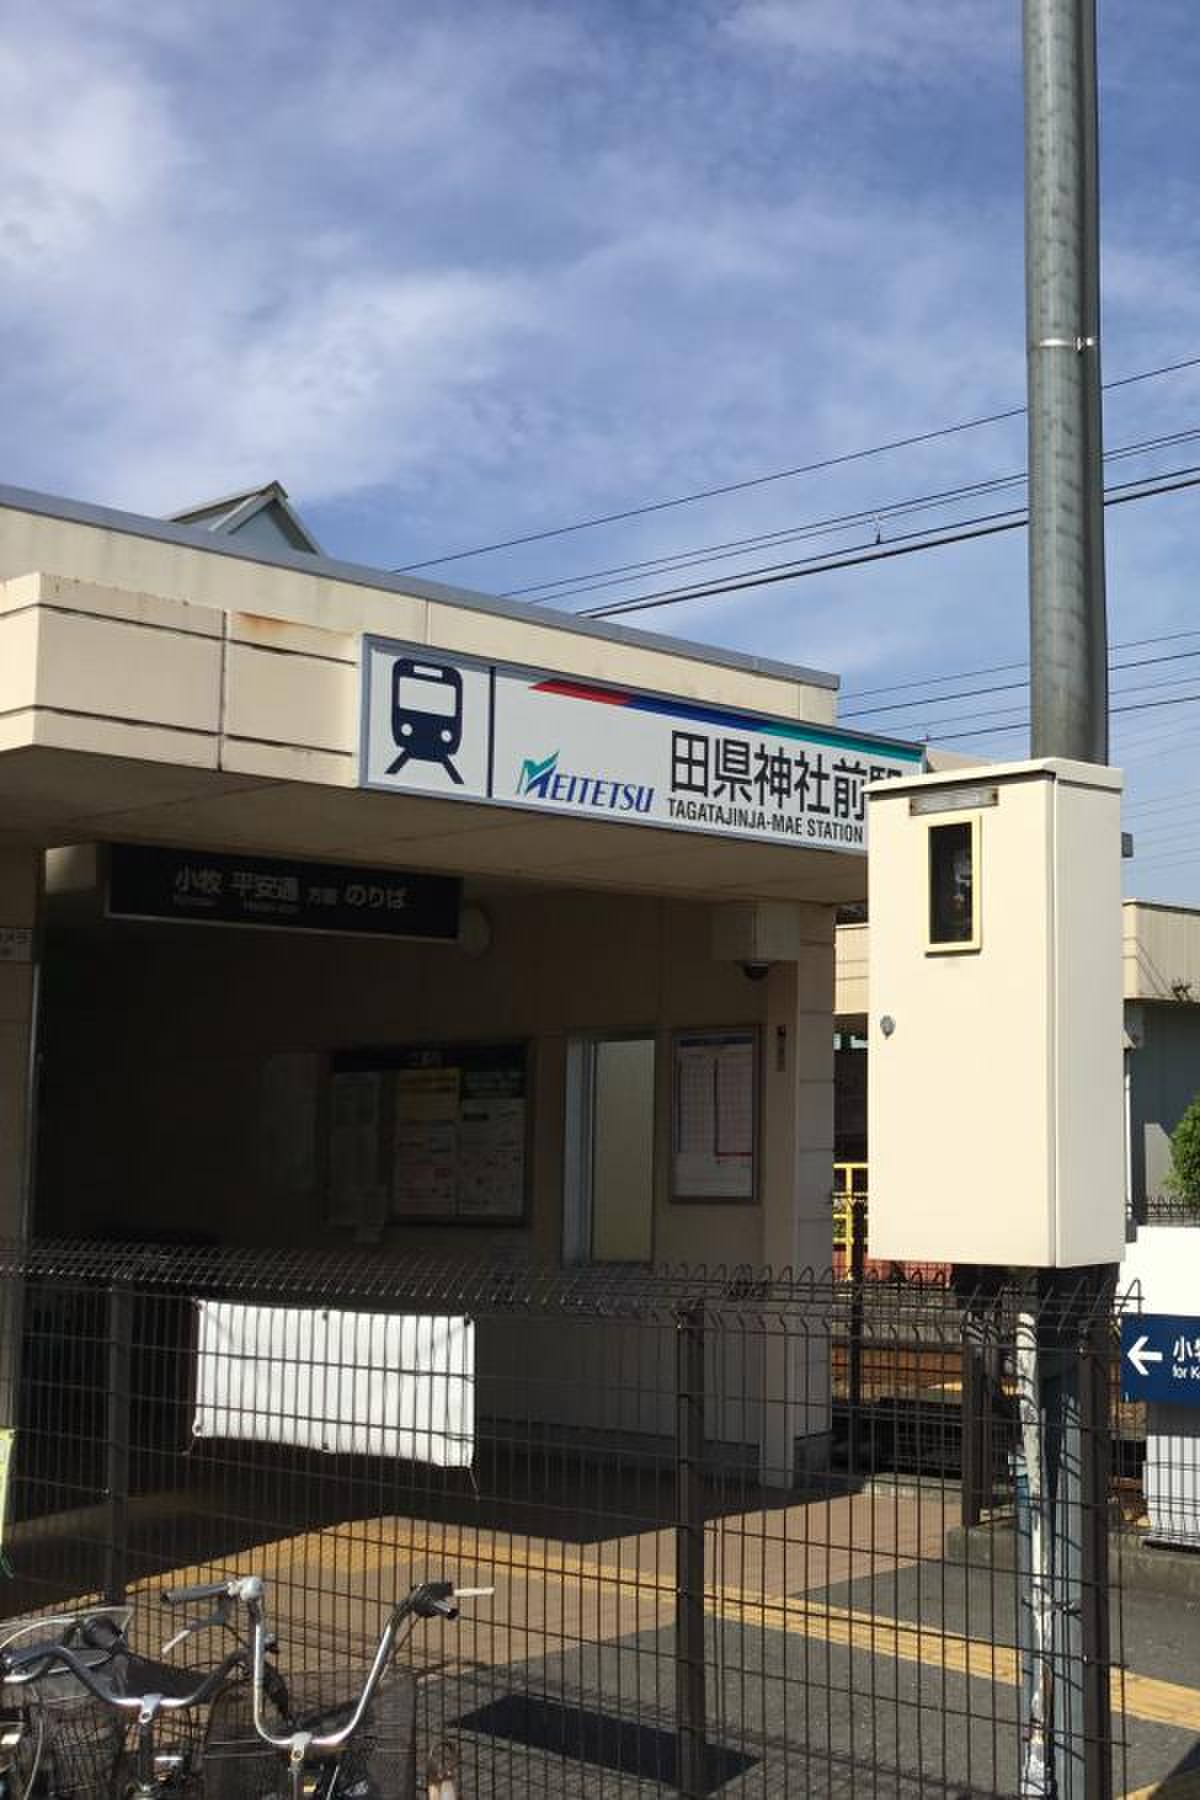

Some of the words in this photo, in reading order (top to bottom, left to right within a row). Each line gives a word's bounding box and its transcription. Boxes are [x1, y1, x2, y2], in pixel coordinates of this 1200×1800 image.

[517, 749, 655, 813] MEITETSU
[668, 797, 803, 837] TAGATAJINJA-MAE
[806, 818, 864, 844] STATION
[345, 883, 408, 910] のりば
[1172, 1364, 1188, 1379] for
